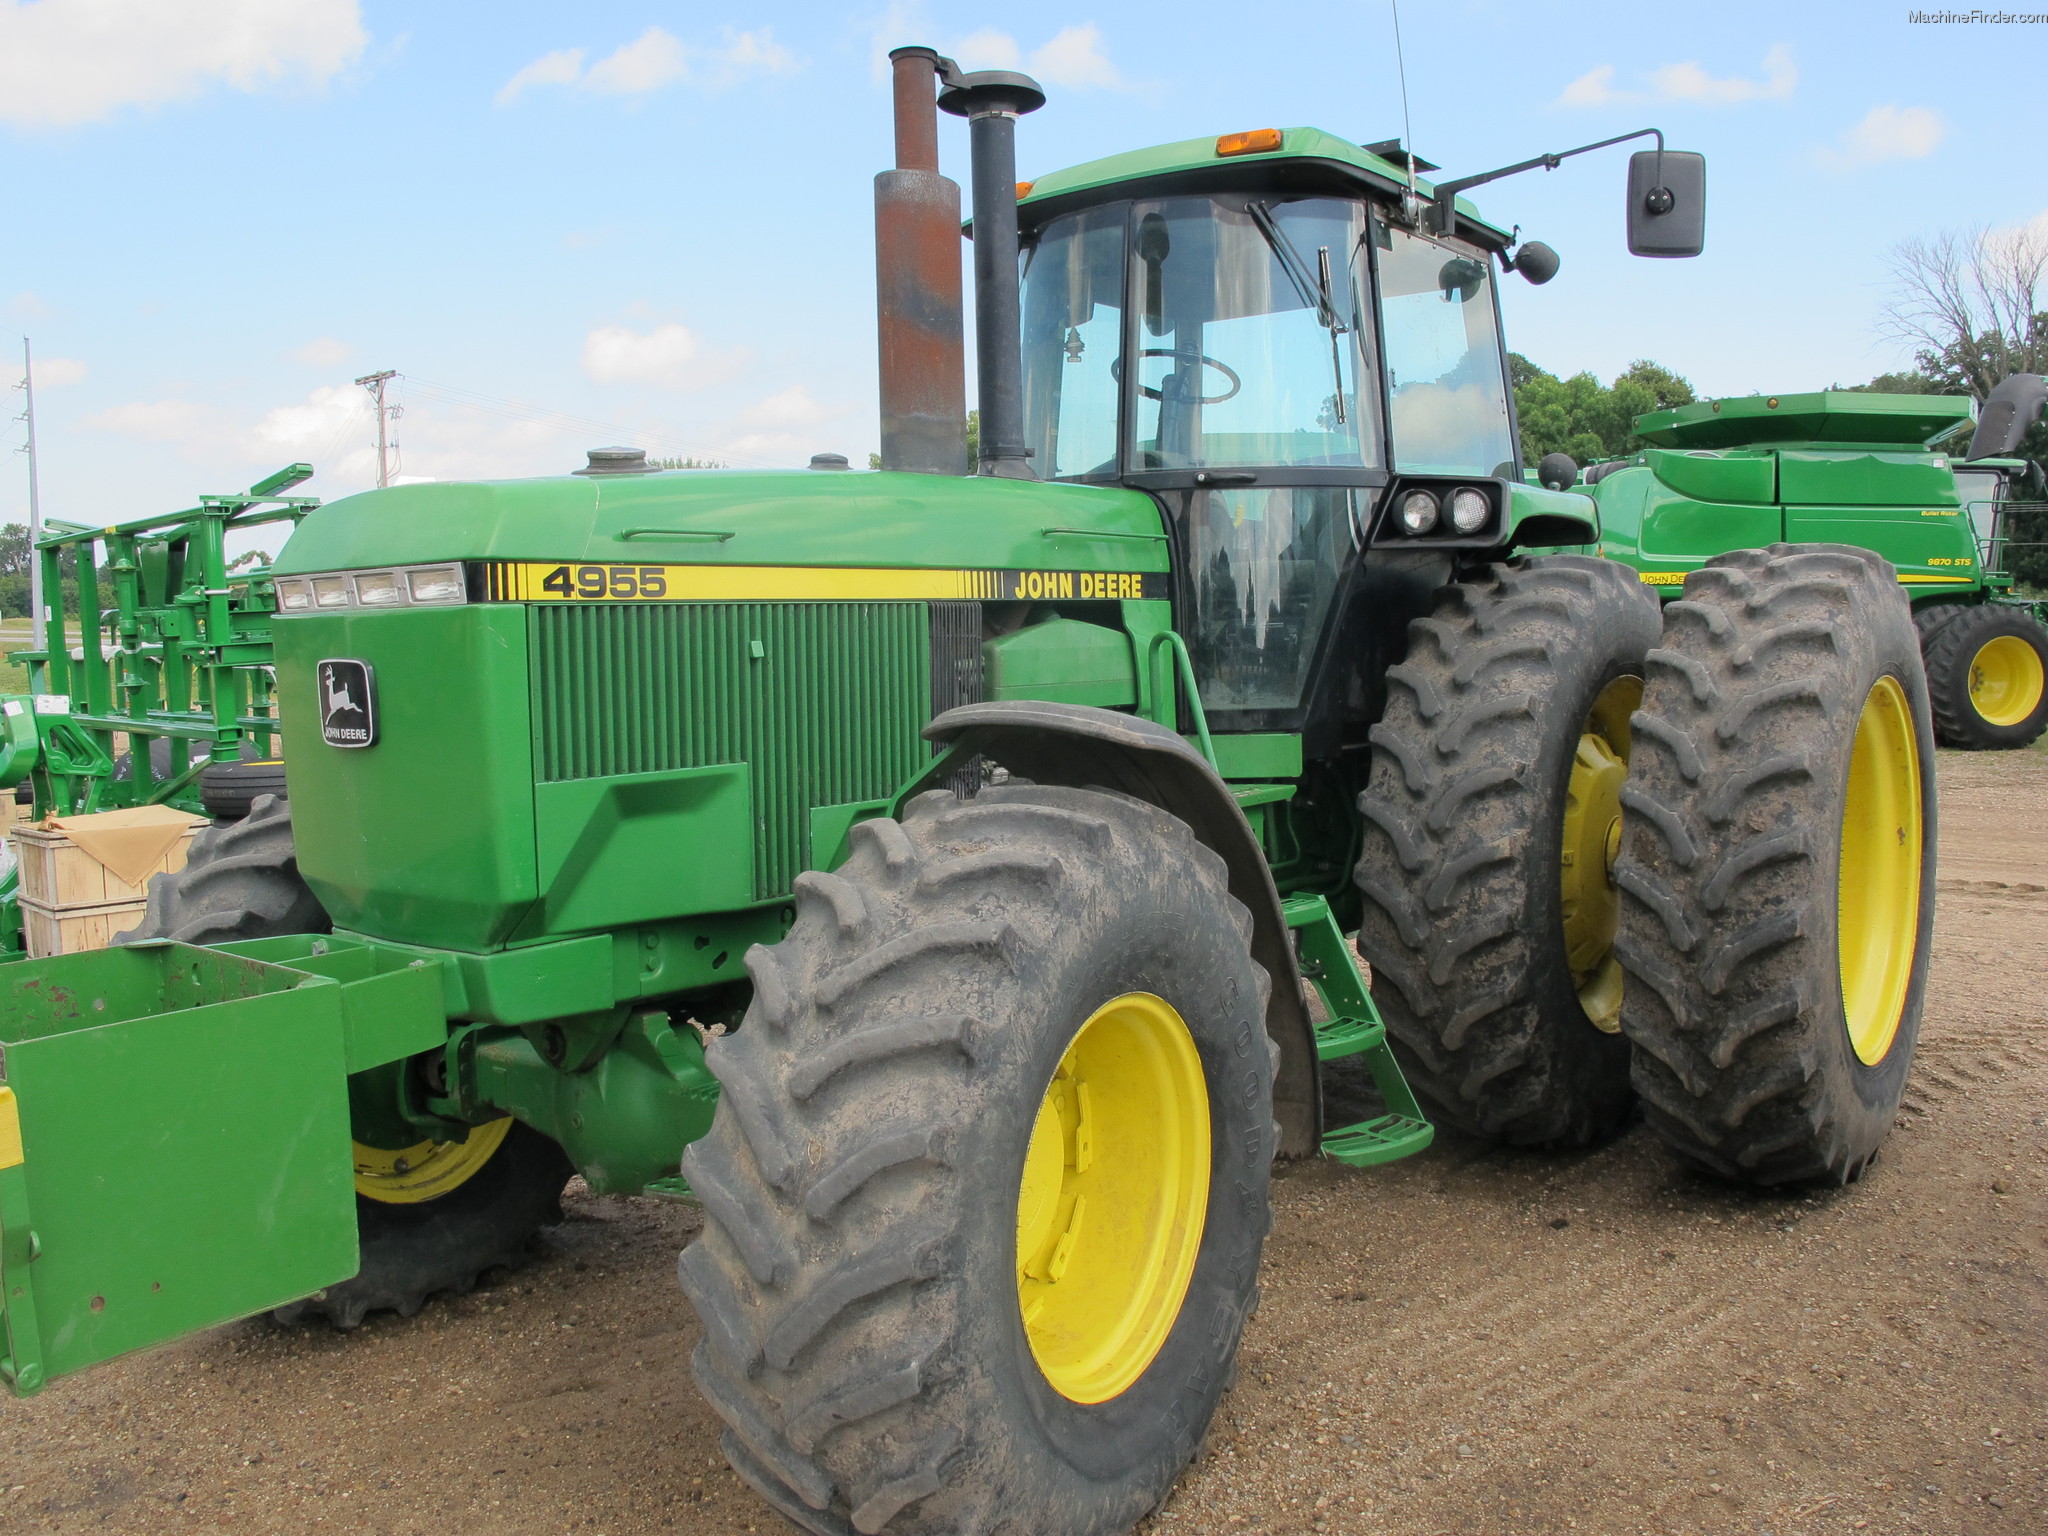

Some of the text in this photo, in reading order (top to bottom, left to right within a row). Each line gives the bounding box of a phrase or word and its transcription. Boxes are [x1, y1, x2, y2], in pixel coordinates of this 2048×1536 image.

[1928, 558, 1972, 566] 9870 STS
[543, 566, 667, 598] 4955
[1014, 571, 1142, 599] JOHN DEERE
[1643, 574, 1669, 584] JOHN
[325, 726, 368, 740] JOHN DEERE
